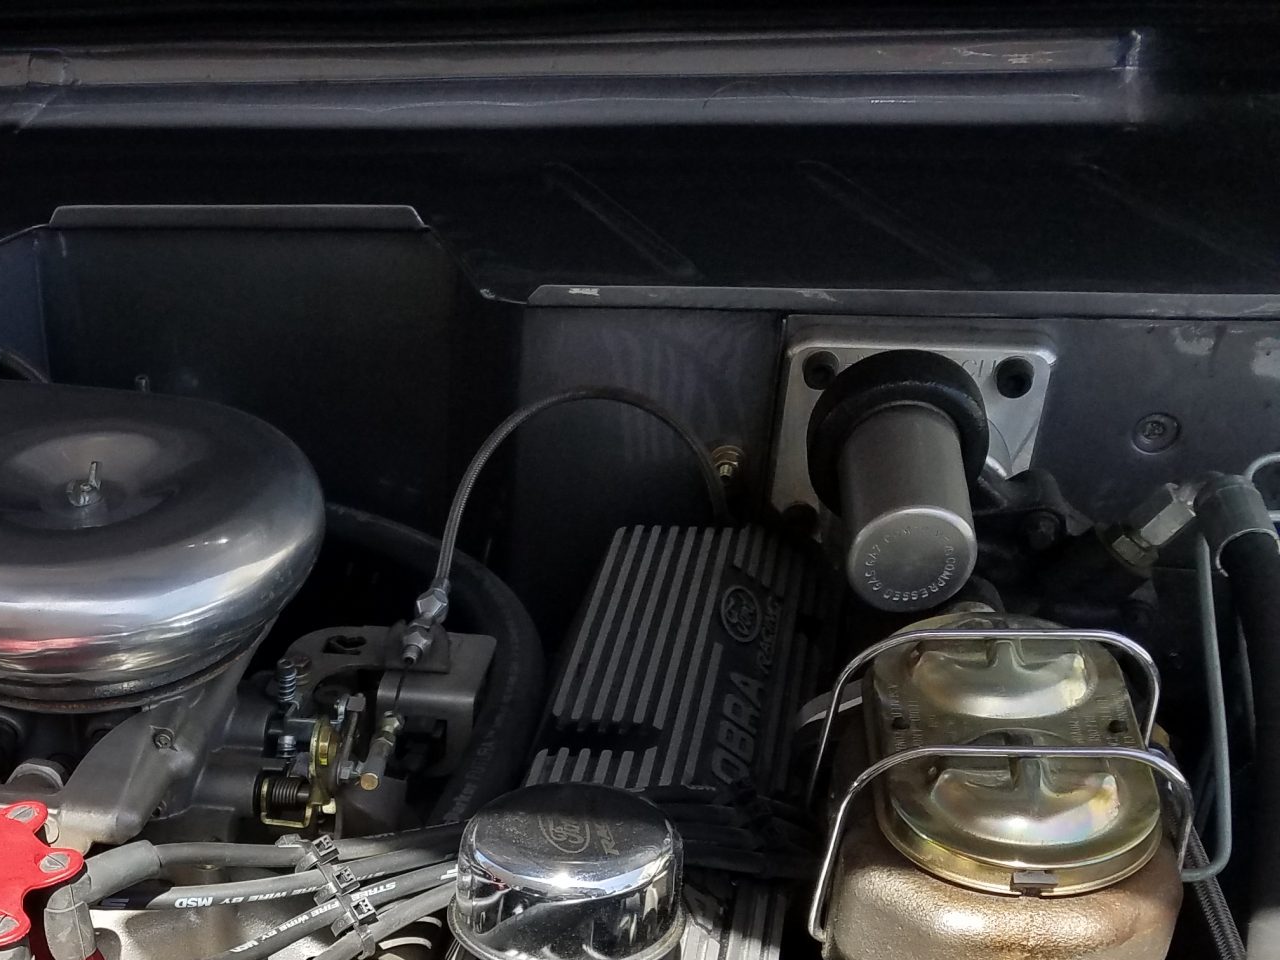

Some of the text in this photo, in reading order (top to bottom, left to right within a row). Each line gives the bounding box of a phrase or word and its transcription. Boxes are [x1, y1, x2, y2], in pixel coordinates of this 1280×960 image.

[711, 671, 765, 785] OBRA
[350, 881, 397, 902] STREE
[174, 896, 214, 909] MSD
